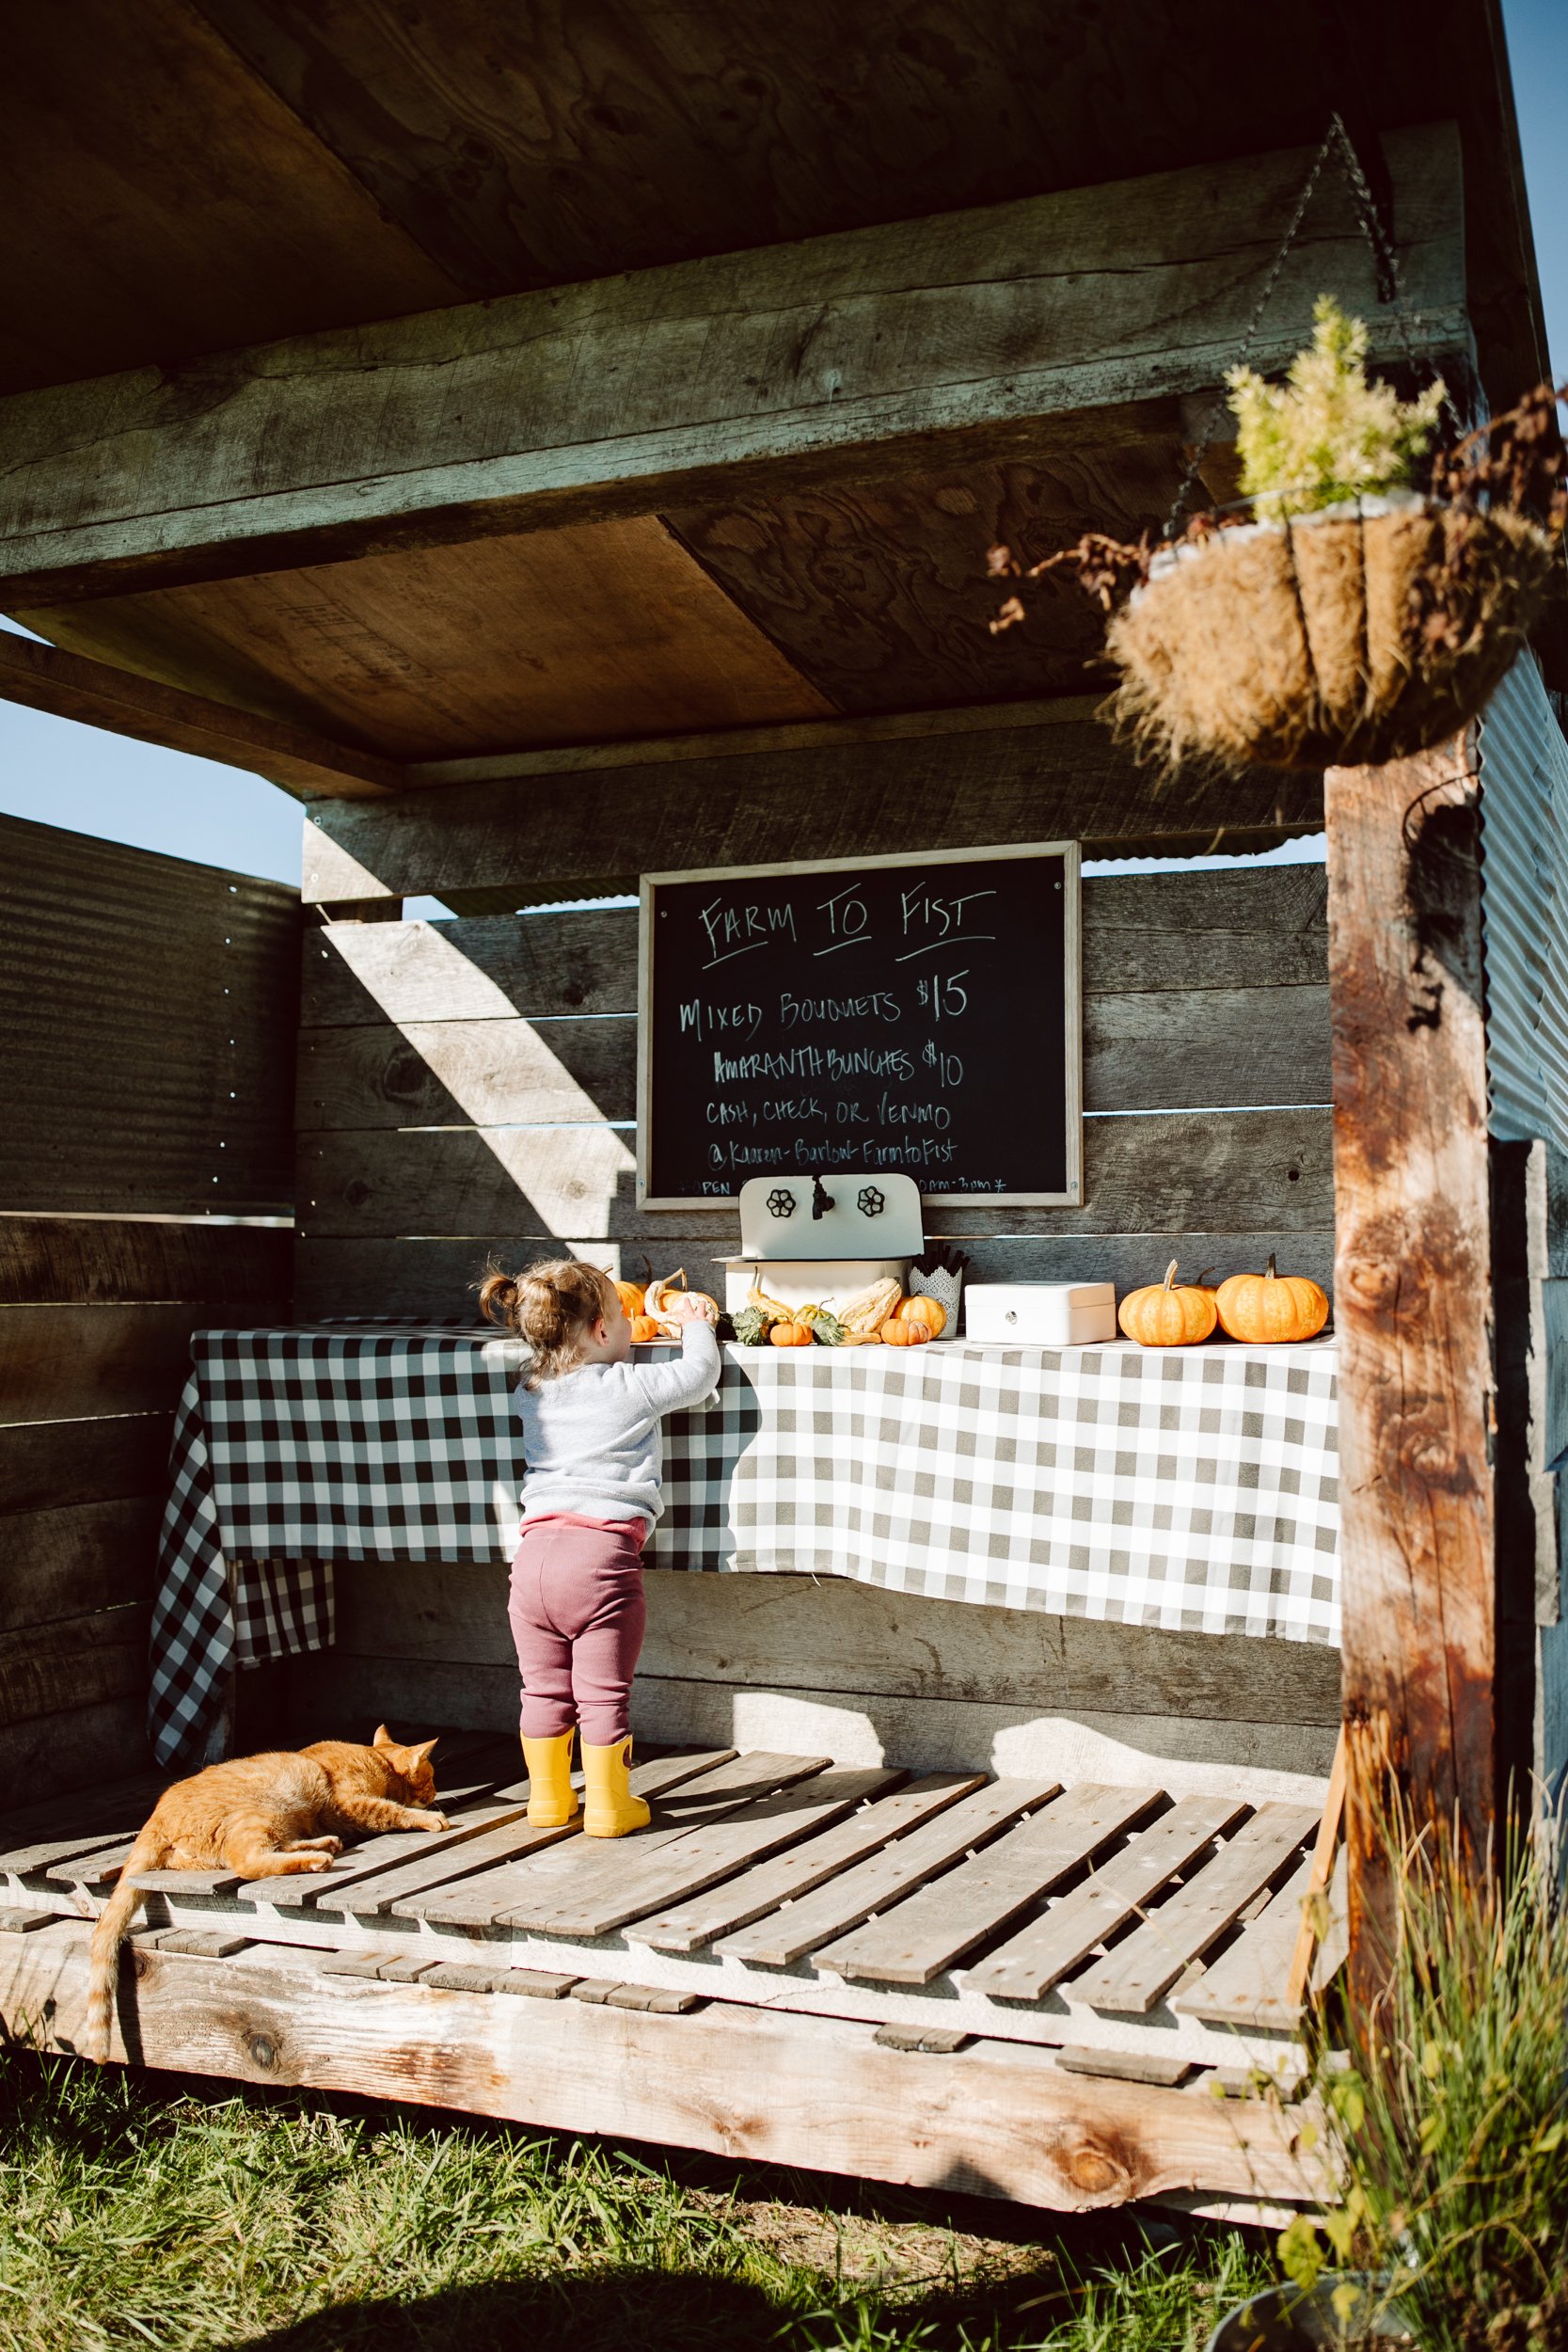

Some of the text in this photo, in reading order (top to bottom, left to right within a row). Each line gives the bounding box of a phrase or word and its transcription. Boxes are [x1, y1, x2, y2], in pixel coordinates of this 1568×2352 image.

[699, 882, 997, 958] FARM TO FIST
[679, 969, 970, 1041] MIXED BOUQUETS $15
[713, 1039, 964, 1088] AMARANTH BUNCHES $10
[706, 1091, 952, 1130] CASH, CHECK, OR VENMO
